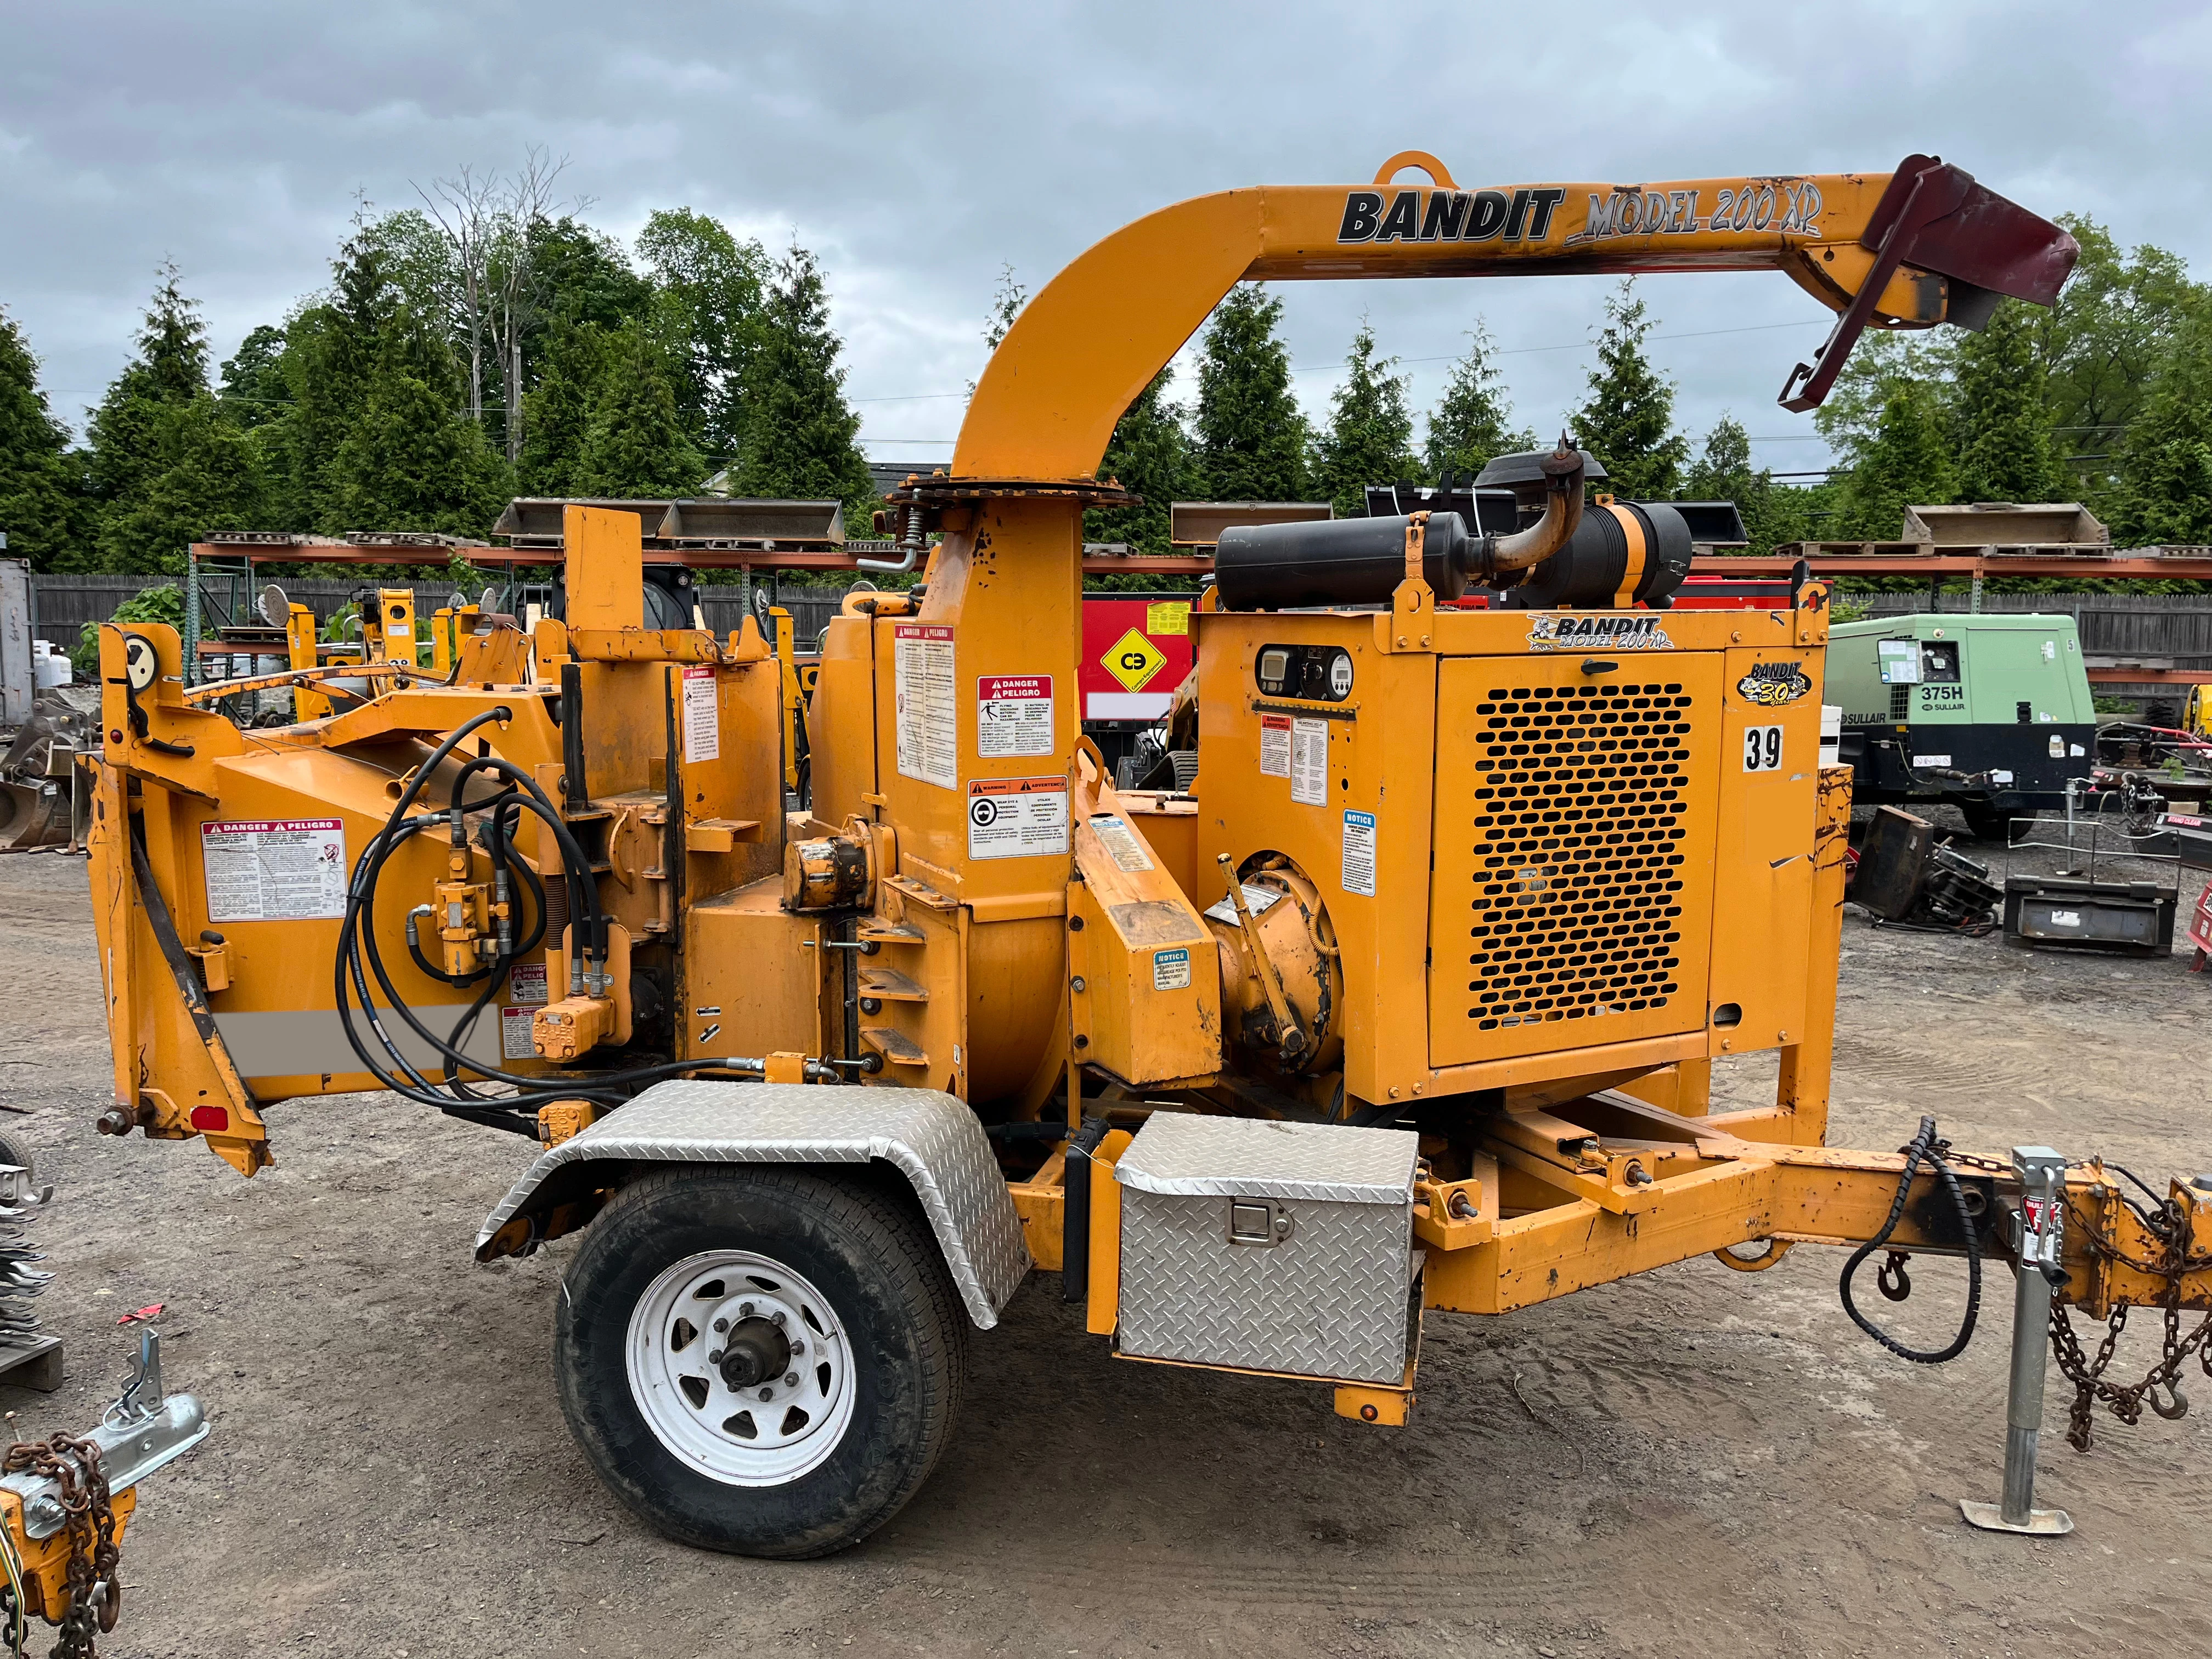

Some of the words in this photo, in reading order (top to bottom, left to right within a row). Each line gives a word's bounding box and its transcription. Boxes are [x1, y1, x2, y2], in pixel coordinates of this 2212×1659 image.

[1338, 189, 1566, 244] BANDIT
[1584, 189, 1699, 239] MODEL
[1707, 185, 1777, 234] 200
[1782, 183, 1821, 236] XP
[904, 628, 920, 636] DANGER
[929, 629, 948, 637] PELIGRO
[1555, 617, 1661, 637] BANDIT
[1559, 635, 1613, 647] MODEL
[1616, 633, 1647, 648] 200
[1647, 630, 1668, 648] XP
[2068, 640, 2073, 651] 5
[1131, 678, 1144, 690] Campo
[1143, 659, 1162, 678] Equipment
[1751, 661, 1802, 680] BANDIT
[1759, 682, 1789, 703] 30
[1921, 686, 1963, 700] 375H
[1770, 698, 1791, 707] Years
[1847, 713, 1886, 724] SULLAIR
[1746, 727, 1780, 770] 39
[287, 821, 334, 830] PELIGRO
[1347, 814, 1372, 825] NOTICE
[2168, 816, 2184, 824] STAND
[2184, 817, 2202, 827] CLEAR
[1159, 952, 1184, 962] NOTICE
